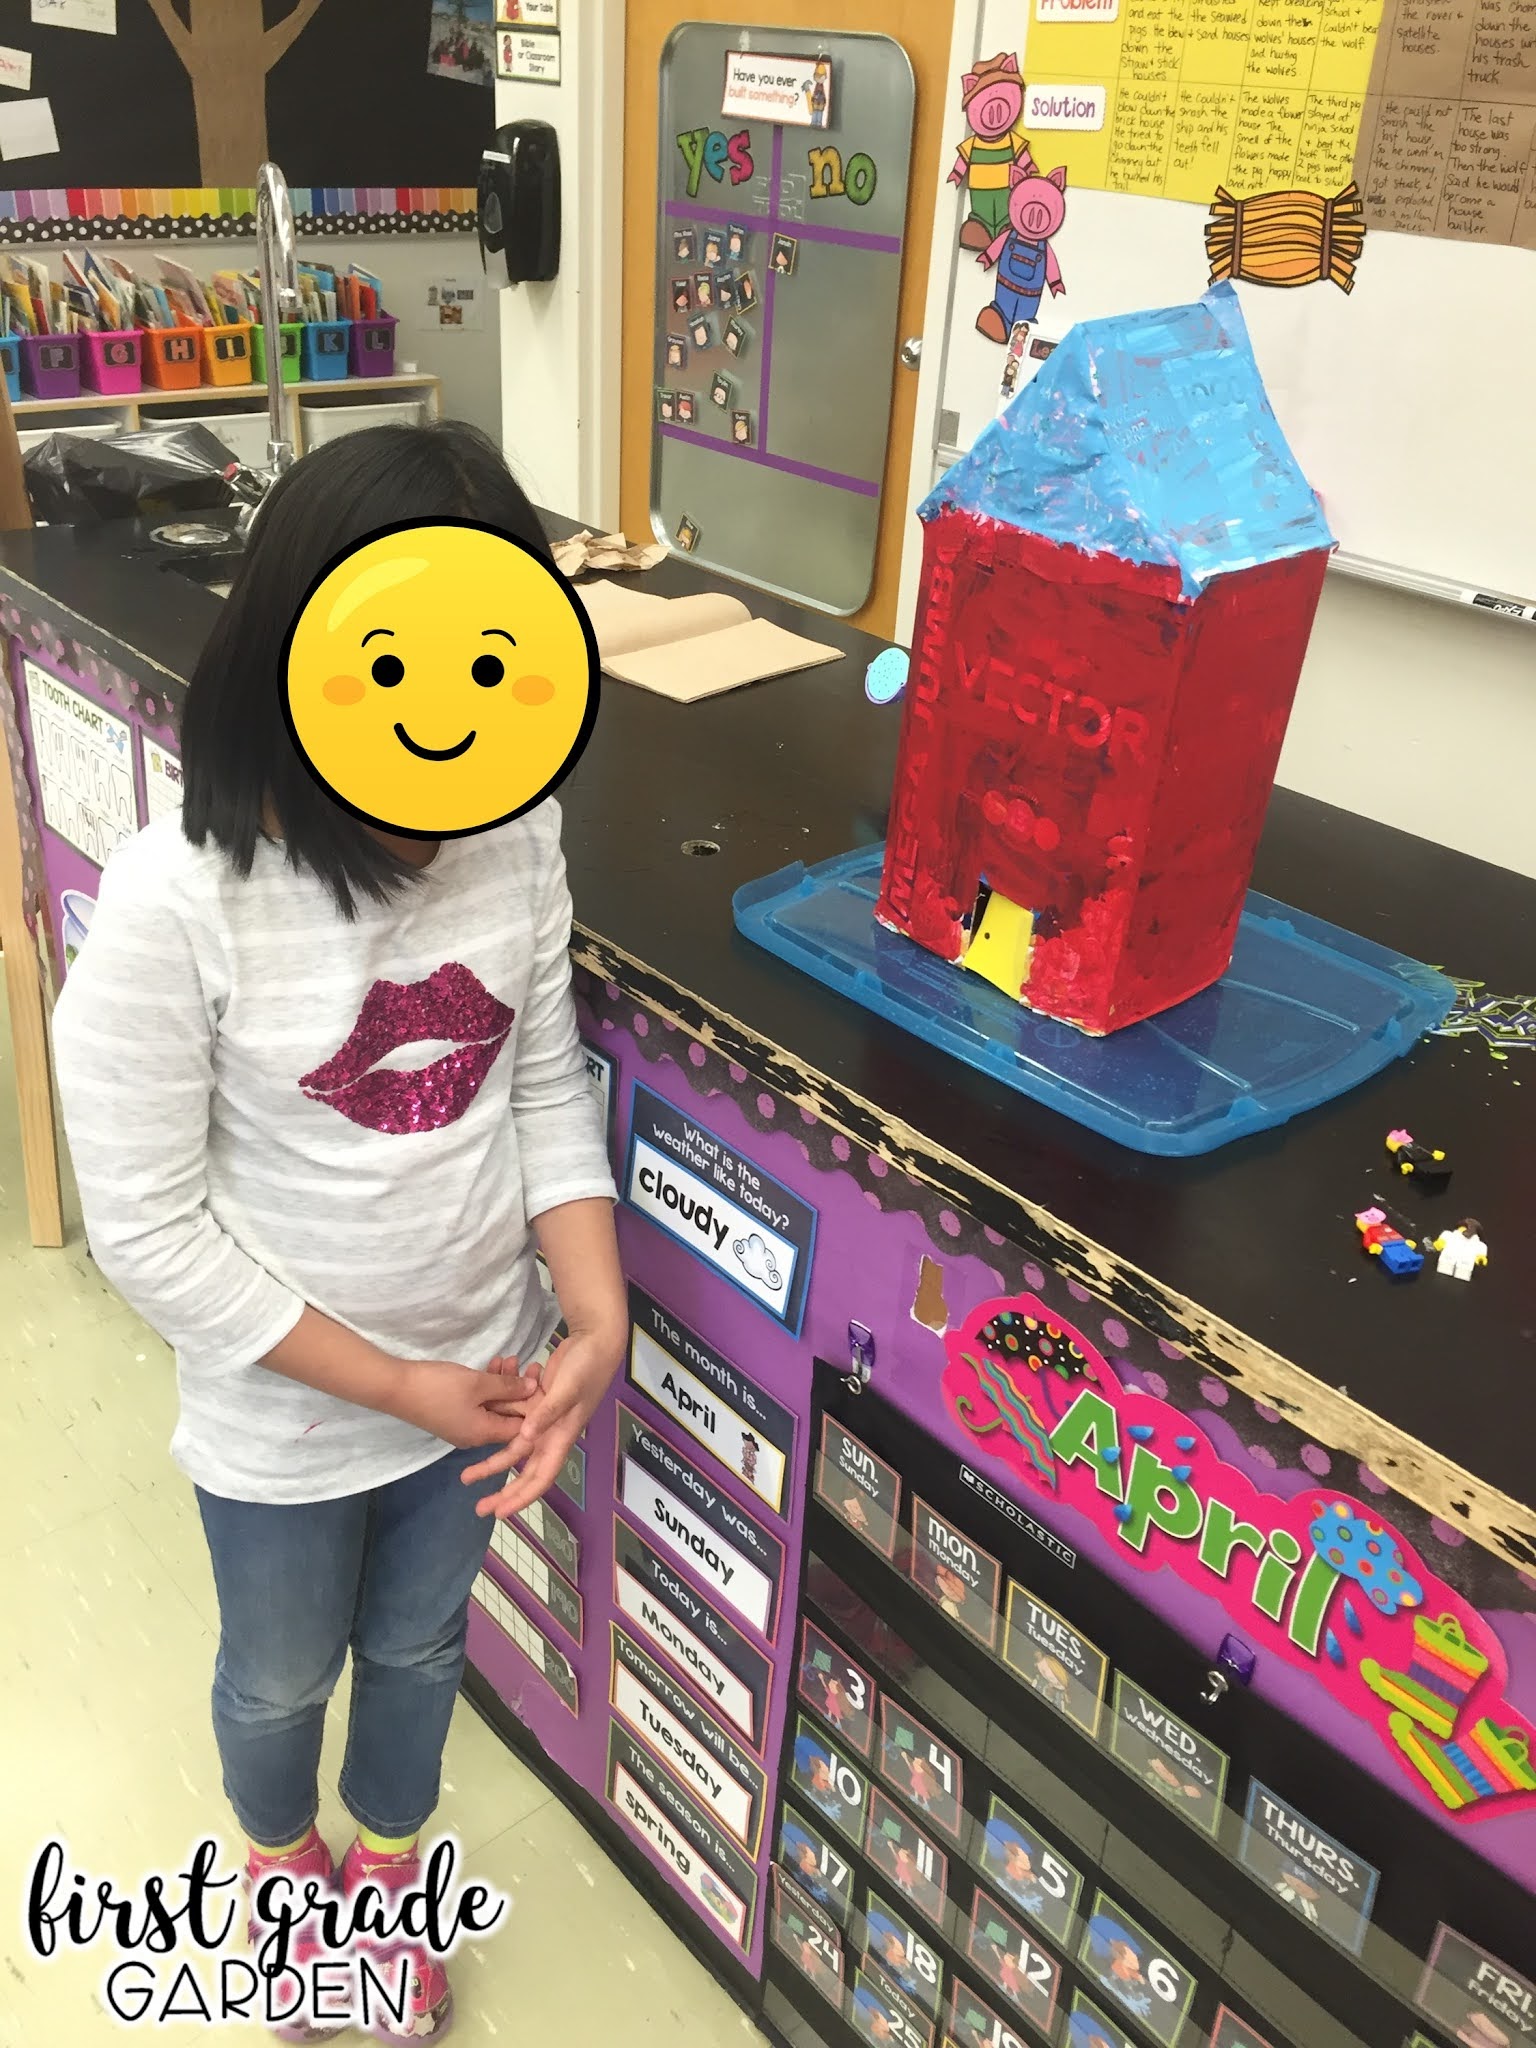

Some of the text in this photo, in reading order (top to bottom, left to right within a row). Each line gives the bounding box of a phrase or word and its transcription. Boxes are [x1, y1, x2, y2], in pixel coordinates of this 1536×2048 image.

[1509, 18, 1532, 32] the
[728, 85, 747, 98] built
[733, 67, 798, 87] Have you ever
[1461, 106, 1483, 124] The
[676, 126, 755, 198] yes
[808, 145, 877, 205] no
[50, 350, 65, 368] F
[173, 342, 191, 360] H
[323, 334, 338, 351] K
[374, 332, 385, 349] L
[43, 680, 103, 735] TOOTH CHART
[954, 640, 1151, 767] VECTOR
[653, 1122, 790, 1231] weather like today?
[683, 1122, 761, 1191] What is the
[638, 1167, 730, 1250] cloudy
[652, 1308, 681, 1347] The
[685, 1342, 738, 1396] month
[661, 1371, 716, 1434] April
[632, 1424, 717, 1509] Yesterday
[838, 1455, 880, 1498] Sunday
[654, 1498, 735, 1586] Sunday
[974, 1479, 1074, 1564] SCHOLASTIC
[1048, 1388, 1342, 1657] April
[652, 1559, 701, 1619] Today
[641, 1601, 725, 1697] Monday
[1026, 1600, 1087, 1666] TUES.
[1026, 1622, 1084, 1677] Tuesday
[617, 1634, 696, 1721] Tomorrow
[700, 1720, 725, 1752] will
[845, 1668, 866, 1711] 3
[639, 1698, 723, 1800] Tuesday
[1123, 1706, 1215, 1786] Wednesday
[1138, 1697, 1202, 1763] WED.
[628, 1745, 655, 1783] The
[658, 1780, 711, 1845] season
[829, 1752, 862, 1806] 10
[929, 1743, 952, 1794] 4
[625, 1789, 692, 1876] spring
[916, 1838, 934, 1882] 11
[1261, 1795, 1360, 1889] THURS.
[1265, 1823, 1348, 1895] Thursday
[820, 1844, 848, 1888] 17
[1038, 1851, 1069, 1899] 5
[778, 1872, 835, 1934] Yesterday
[808, 1925, 839, 1974] 24
[906, 1931, 938, 1985] 18
[1018, 1938, 1053, 1999] 12
[879, 1975, 916, 2019] Today
[1147, 1958, 1180, 2003] 6
[1467, 1978, 1534, 2032] Friday
[1477, 1961, 1534, 2018] FRI.
[888, 2009, 921, 2048] 25
